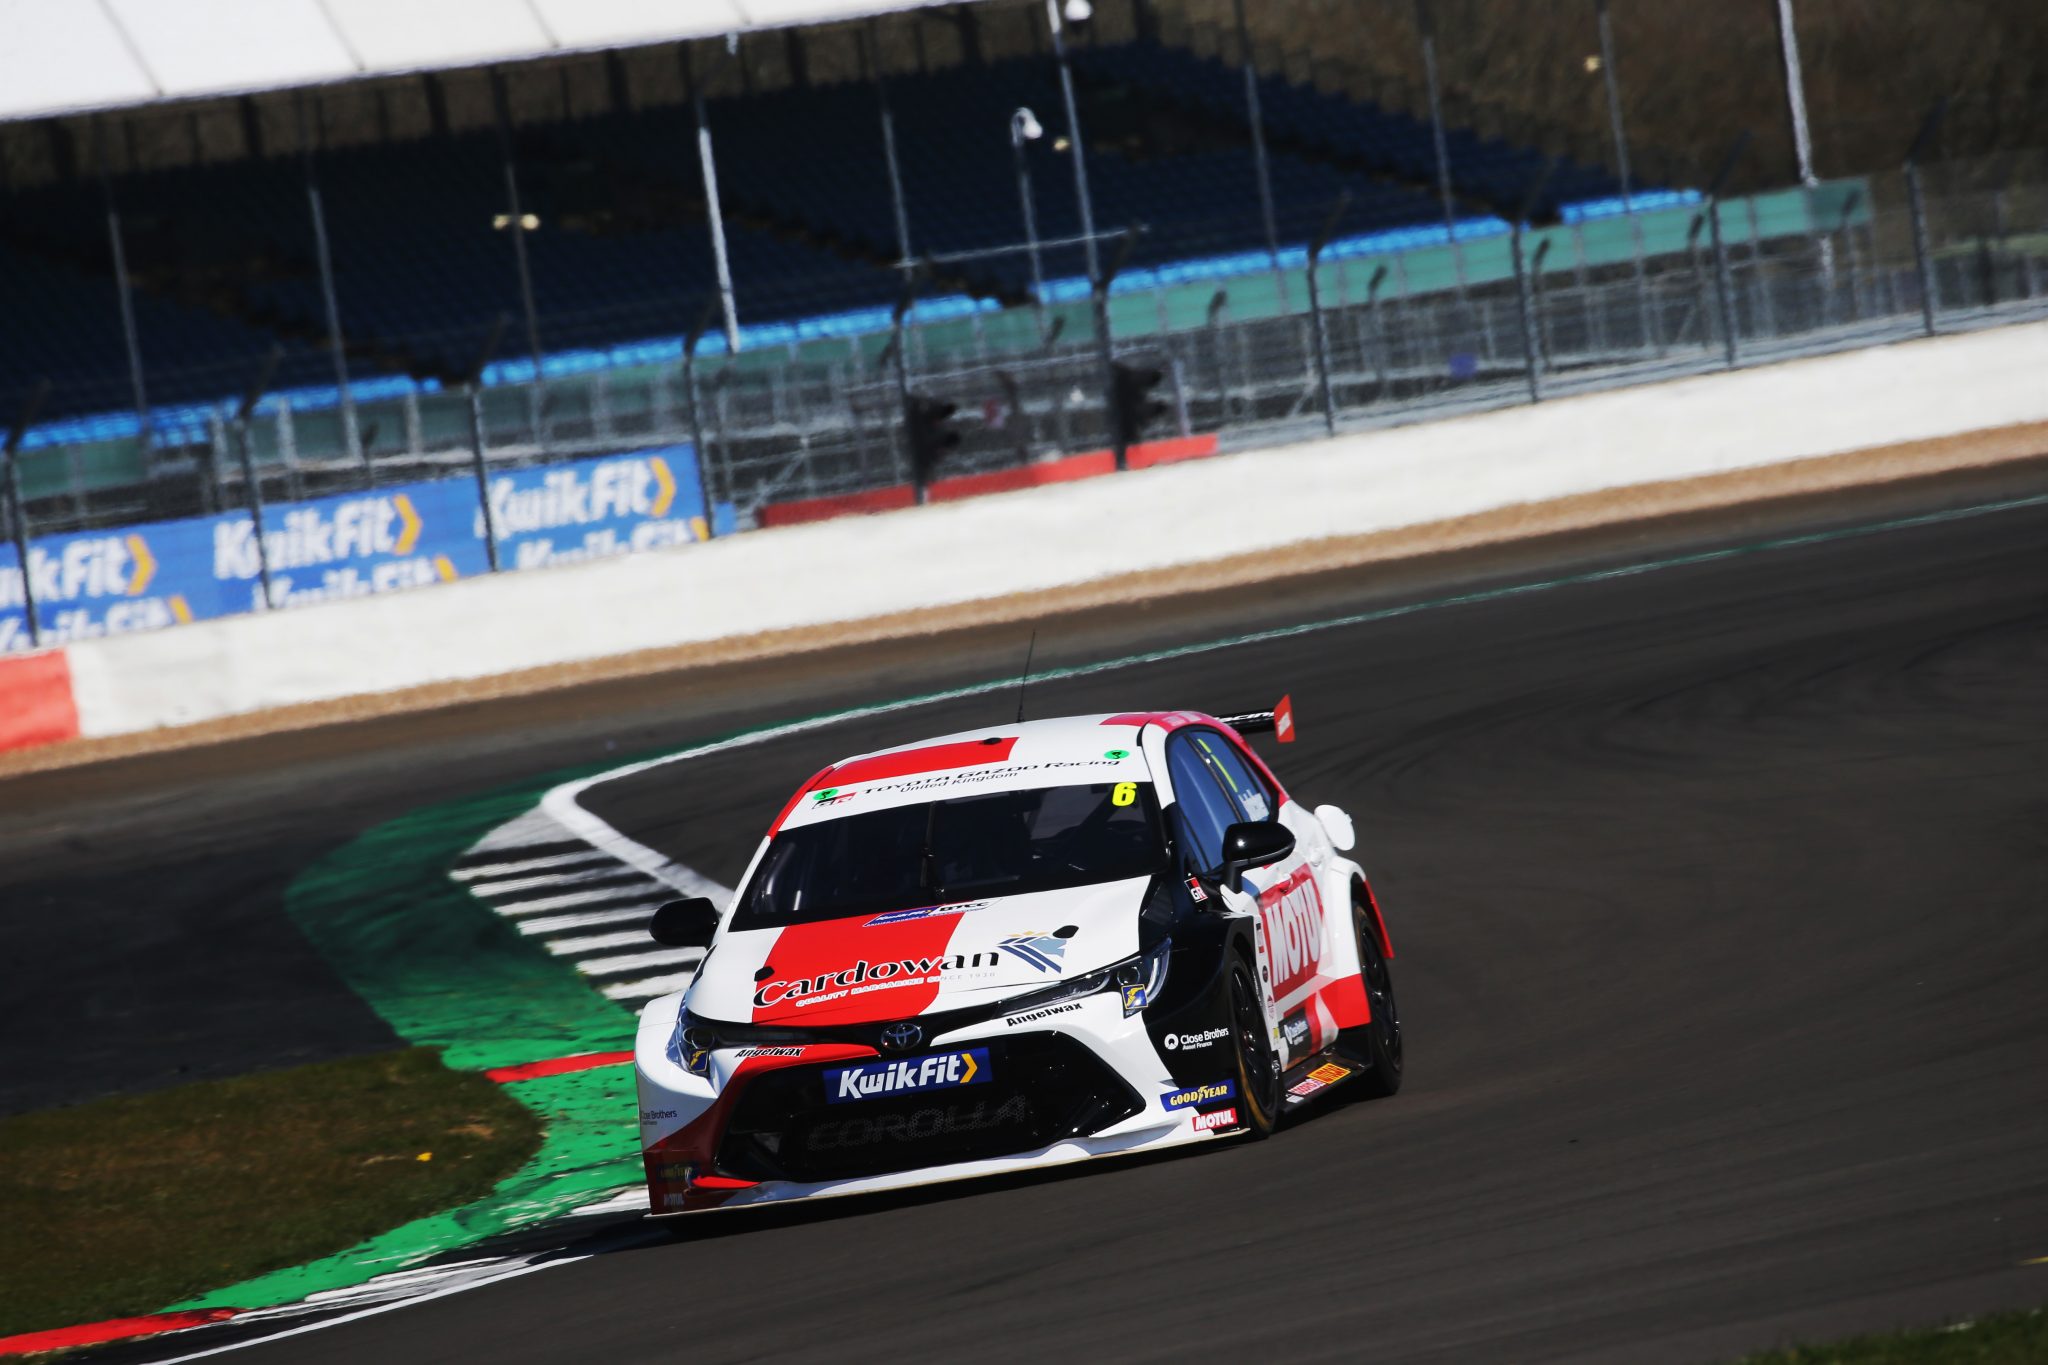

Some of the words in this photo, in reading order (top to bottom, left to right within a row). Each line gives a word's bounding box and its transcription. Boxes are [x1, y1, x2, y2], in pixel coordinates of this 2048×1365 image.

[864, 774, 949, 795] TOYOTA
[1044, 759, 1121, 769] Racing
[900, 781, 950, 793] United
[951, 771, 1019, 786] Kingdom
[1111, 782, 1138, 807] 6
[752, 951, 1000, 1009] Cardowan
[796, 989, 849, 1008] QUALITY
[851, 977, 924, 996] MARGARINE
[927, 974, 963, 984] SINCE
[1006, 1003, 1083, 1027] Angelwax
[1180, 1034, 1204, 1045] Close
[1203, 1027, 1229, 1041] Brothers
[734, 1046, 804, 1058] Angelwax
[1170, 1085, 1228, 1106] GOODYEAR
[1195, 1109, 1234, 1131] MOTUL
